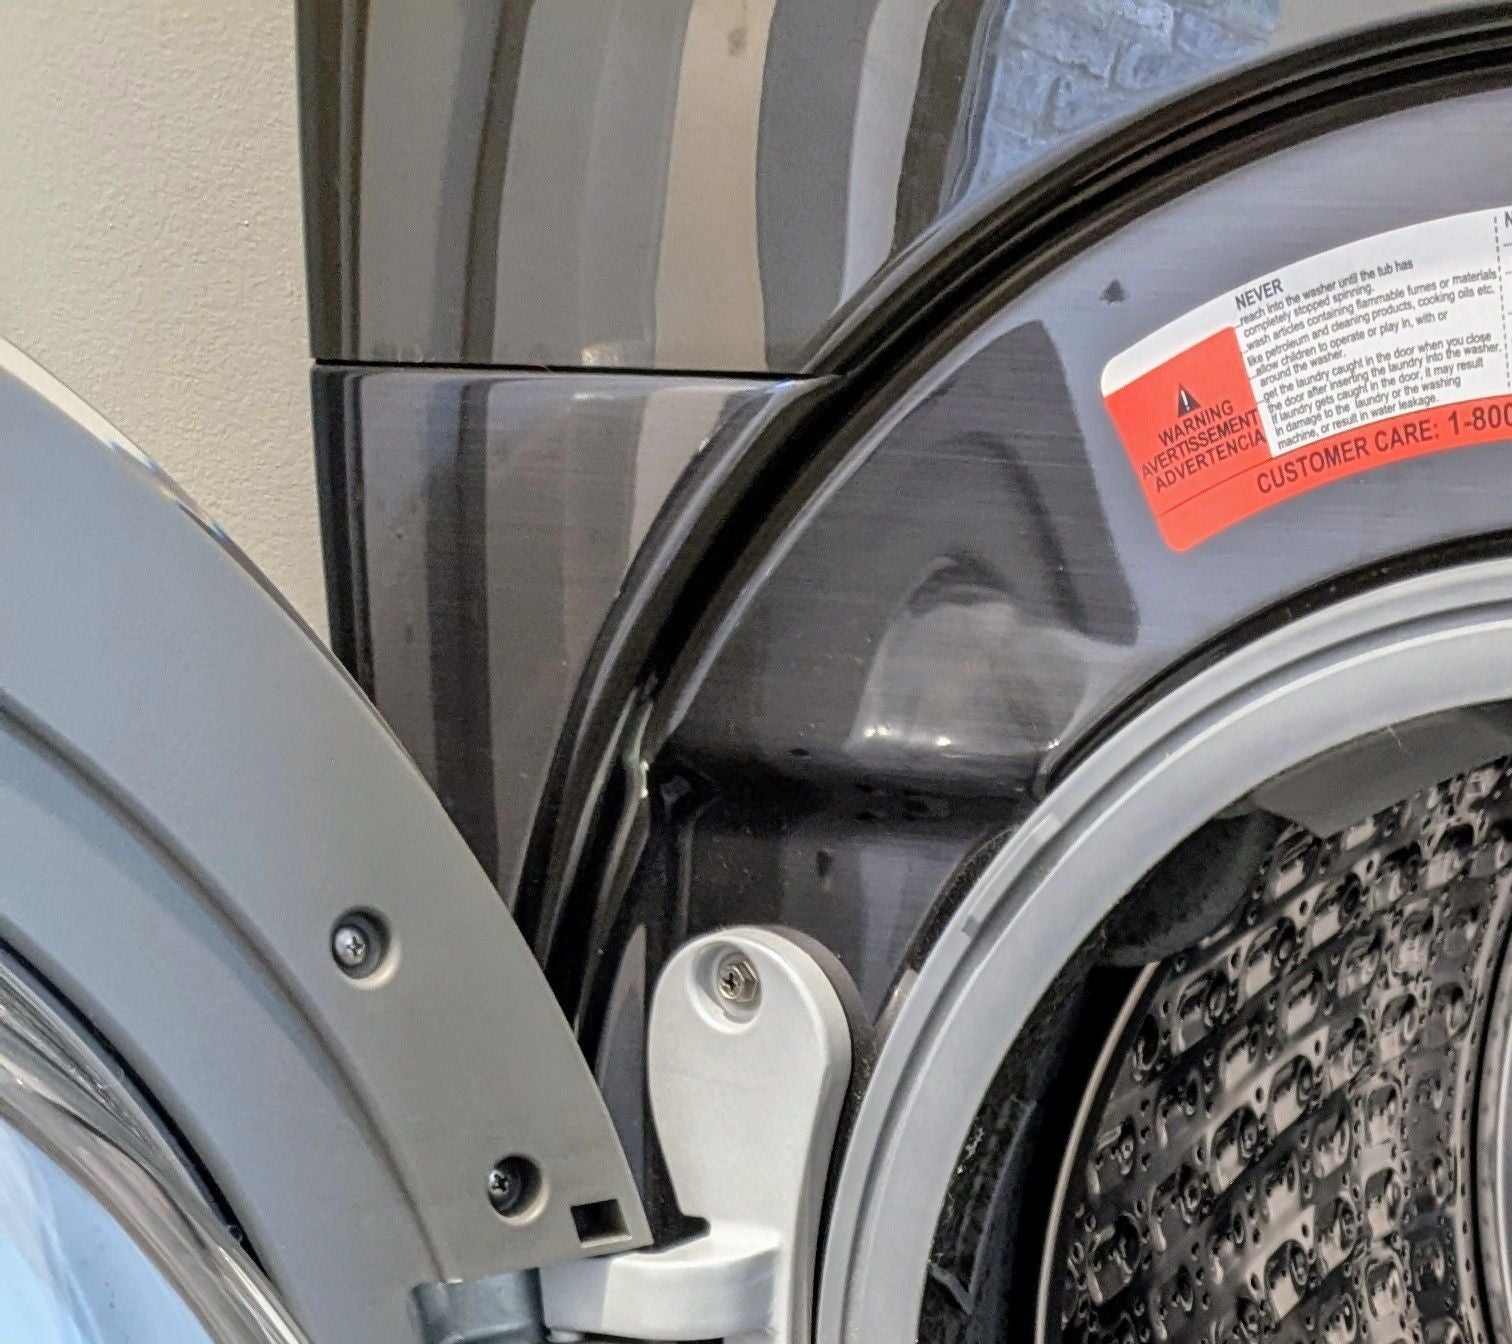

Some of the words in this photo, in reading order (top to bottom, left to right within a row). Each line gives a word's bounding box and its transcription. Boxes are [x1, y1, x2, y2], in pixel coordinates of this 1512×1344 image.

[1234, 278, 1284, 310] NEVER
[1285, 293, 1301, 307] the
[1302, 281, 1337, 300] washer
[1394, 259, 1414, 273] has
[1439, 278, 1450, 289] or
[1452, 268, 1497, 285] materials
[1311, 323, 1330, 340] and
[1418, 292, 1455, 307] cooking
[1318, 342, 1328, 352] to
[1380, 321, 1399, 336] play
[1292, 362, 1308, 374] the
[1376, 351, 1391, 363] the
[1394, 345, 1415, 358] door
[1418, 340, 1444, 353] when
[1466, 332, 1492, 344] close
[1284, 392, 1304, 407] door
[1371, 366, 1386, 377] the
[1445, 348, 1461, 359] the
[1142, 408, 1259, 478] AVERTISSEMENT
[1158, 399, 1234, 447] WARNING
[1155, 429, 1266, 493] ADVERTENCIA
[1256, 437, 1368, 494] CUSTOMER
[1374, 419, 1440, 453] CARE:
